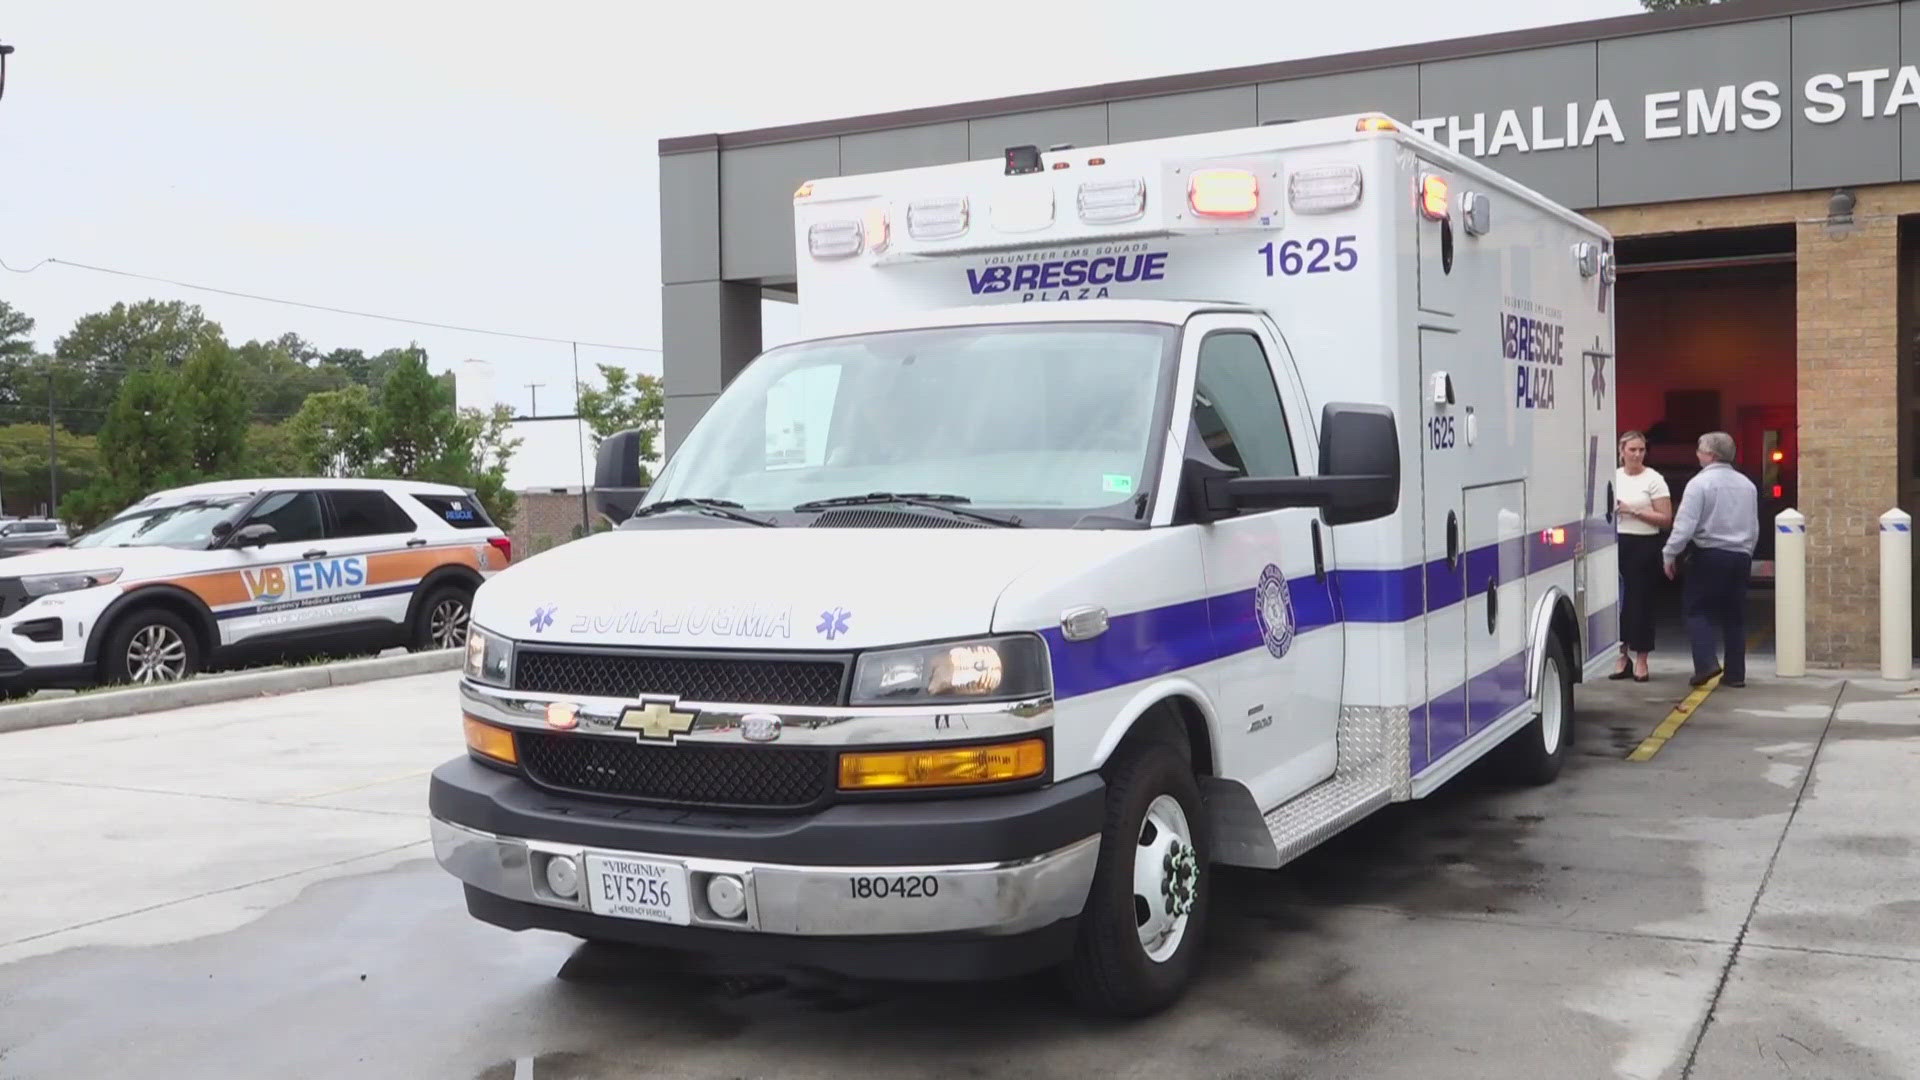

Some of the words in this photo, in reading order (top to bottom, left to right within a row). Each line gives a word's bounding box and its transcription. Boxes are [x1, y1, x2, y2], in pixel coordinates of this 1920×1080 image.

[1412, 98, 1625, 157] THALIA
[1645, 80, 1782, 141] EMS
[1803, 64, 1920, 124] STA
[984, 251, 1056, 265] VOLUNTEER
[1062, 247, 1090, 259] EMS
[1096, 242, 1150, 255] SQUADS
[1257, 235, 1359, 277] 1625
[1021, 287, 1110, 303] PLAZA
[1516, 365, 1555, 409] PLAZA
[1428, 416, 1455, 450] 1625
[243, 566, 286, 599] VB
[292, 558, 363, 593] EMS
[256, 600, 300, 613] Emergency
[301, 596, 330, 606] Medical
[331, 593, 362, 603] Services
[608, 861, 662, 877] VIRGINIA
[602, 873, 671, 907] EV5256
[849, 875, 939, 898] 180420
